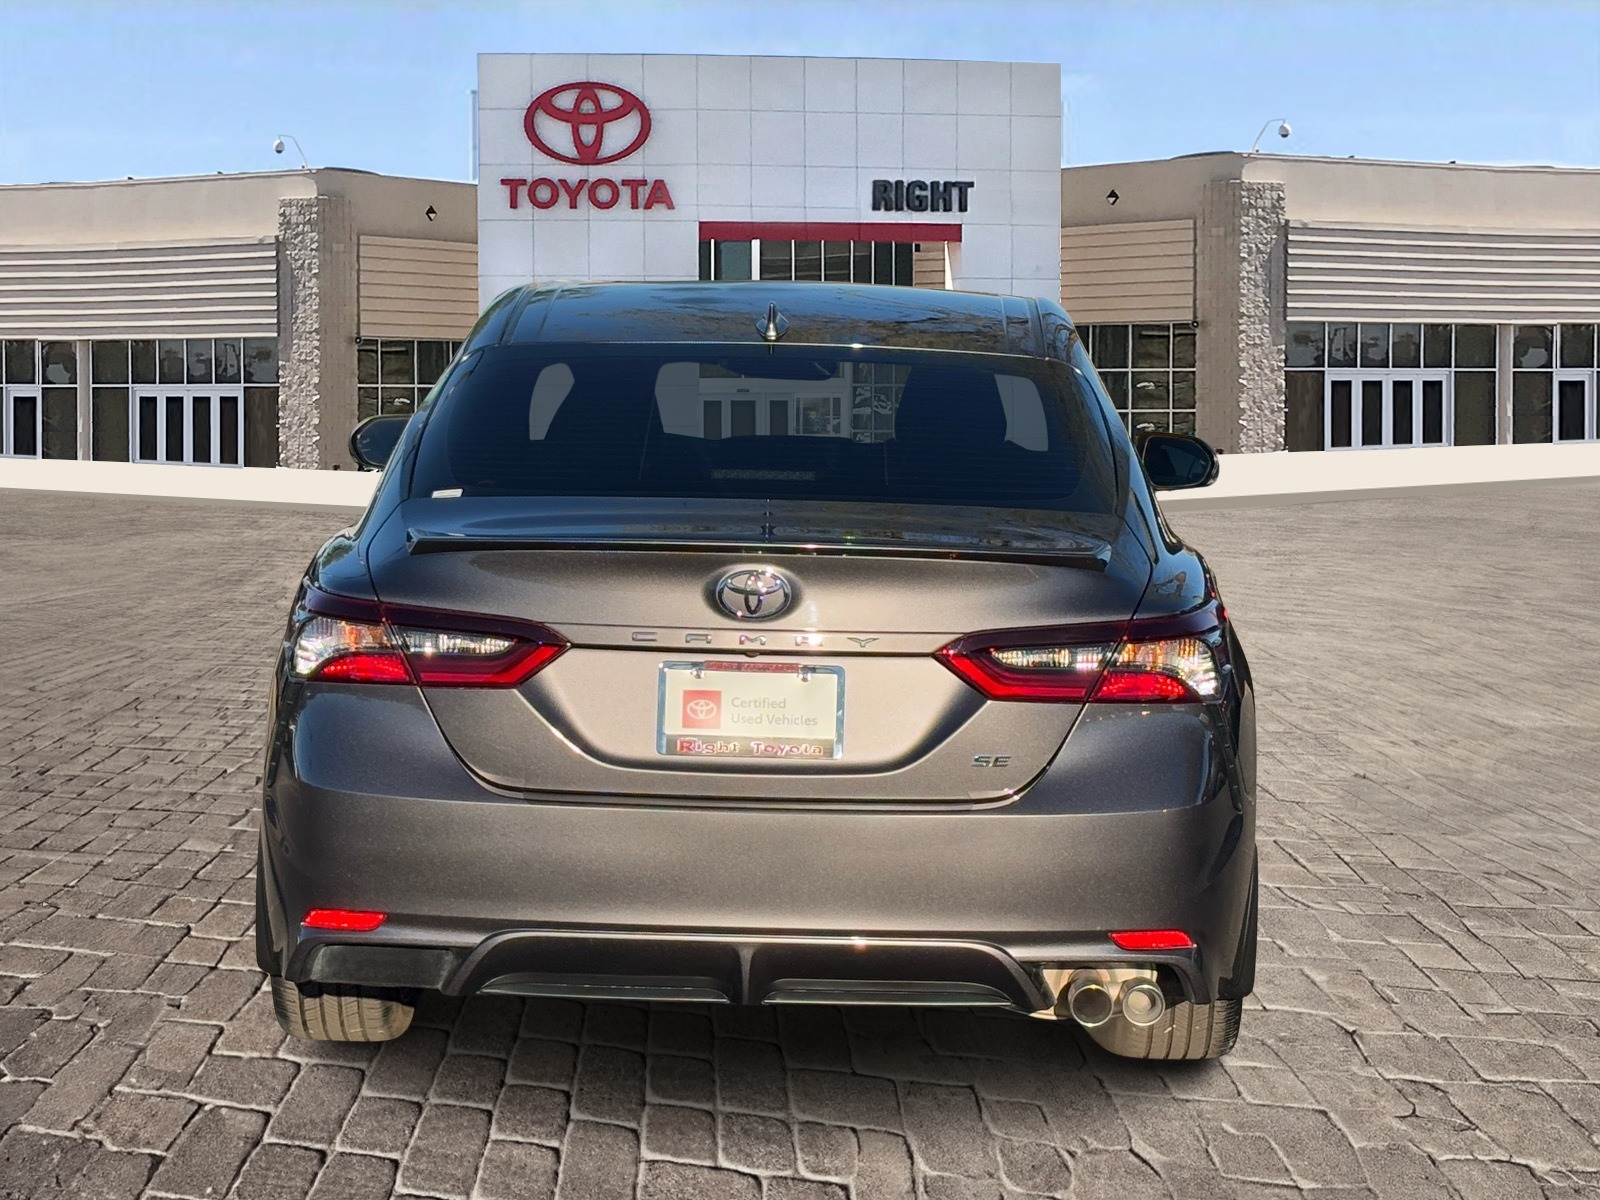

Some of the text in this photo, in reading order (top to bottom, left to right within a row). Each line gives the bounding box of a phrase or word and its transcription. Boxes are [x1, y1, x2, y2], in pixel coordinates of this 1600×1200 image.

[500, 178, 675, 210] TOYOTA
[871, 179, 975, 212] RIGHT
[731, 697, 787, 709] Certified
[731, 713, 818, 726] Used Vehicles
[677, 737, 824, 756] Right Toyota
[972, 755, 1012, 767] SE
